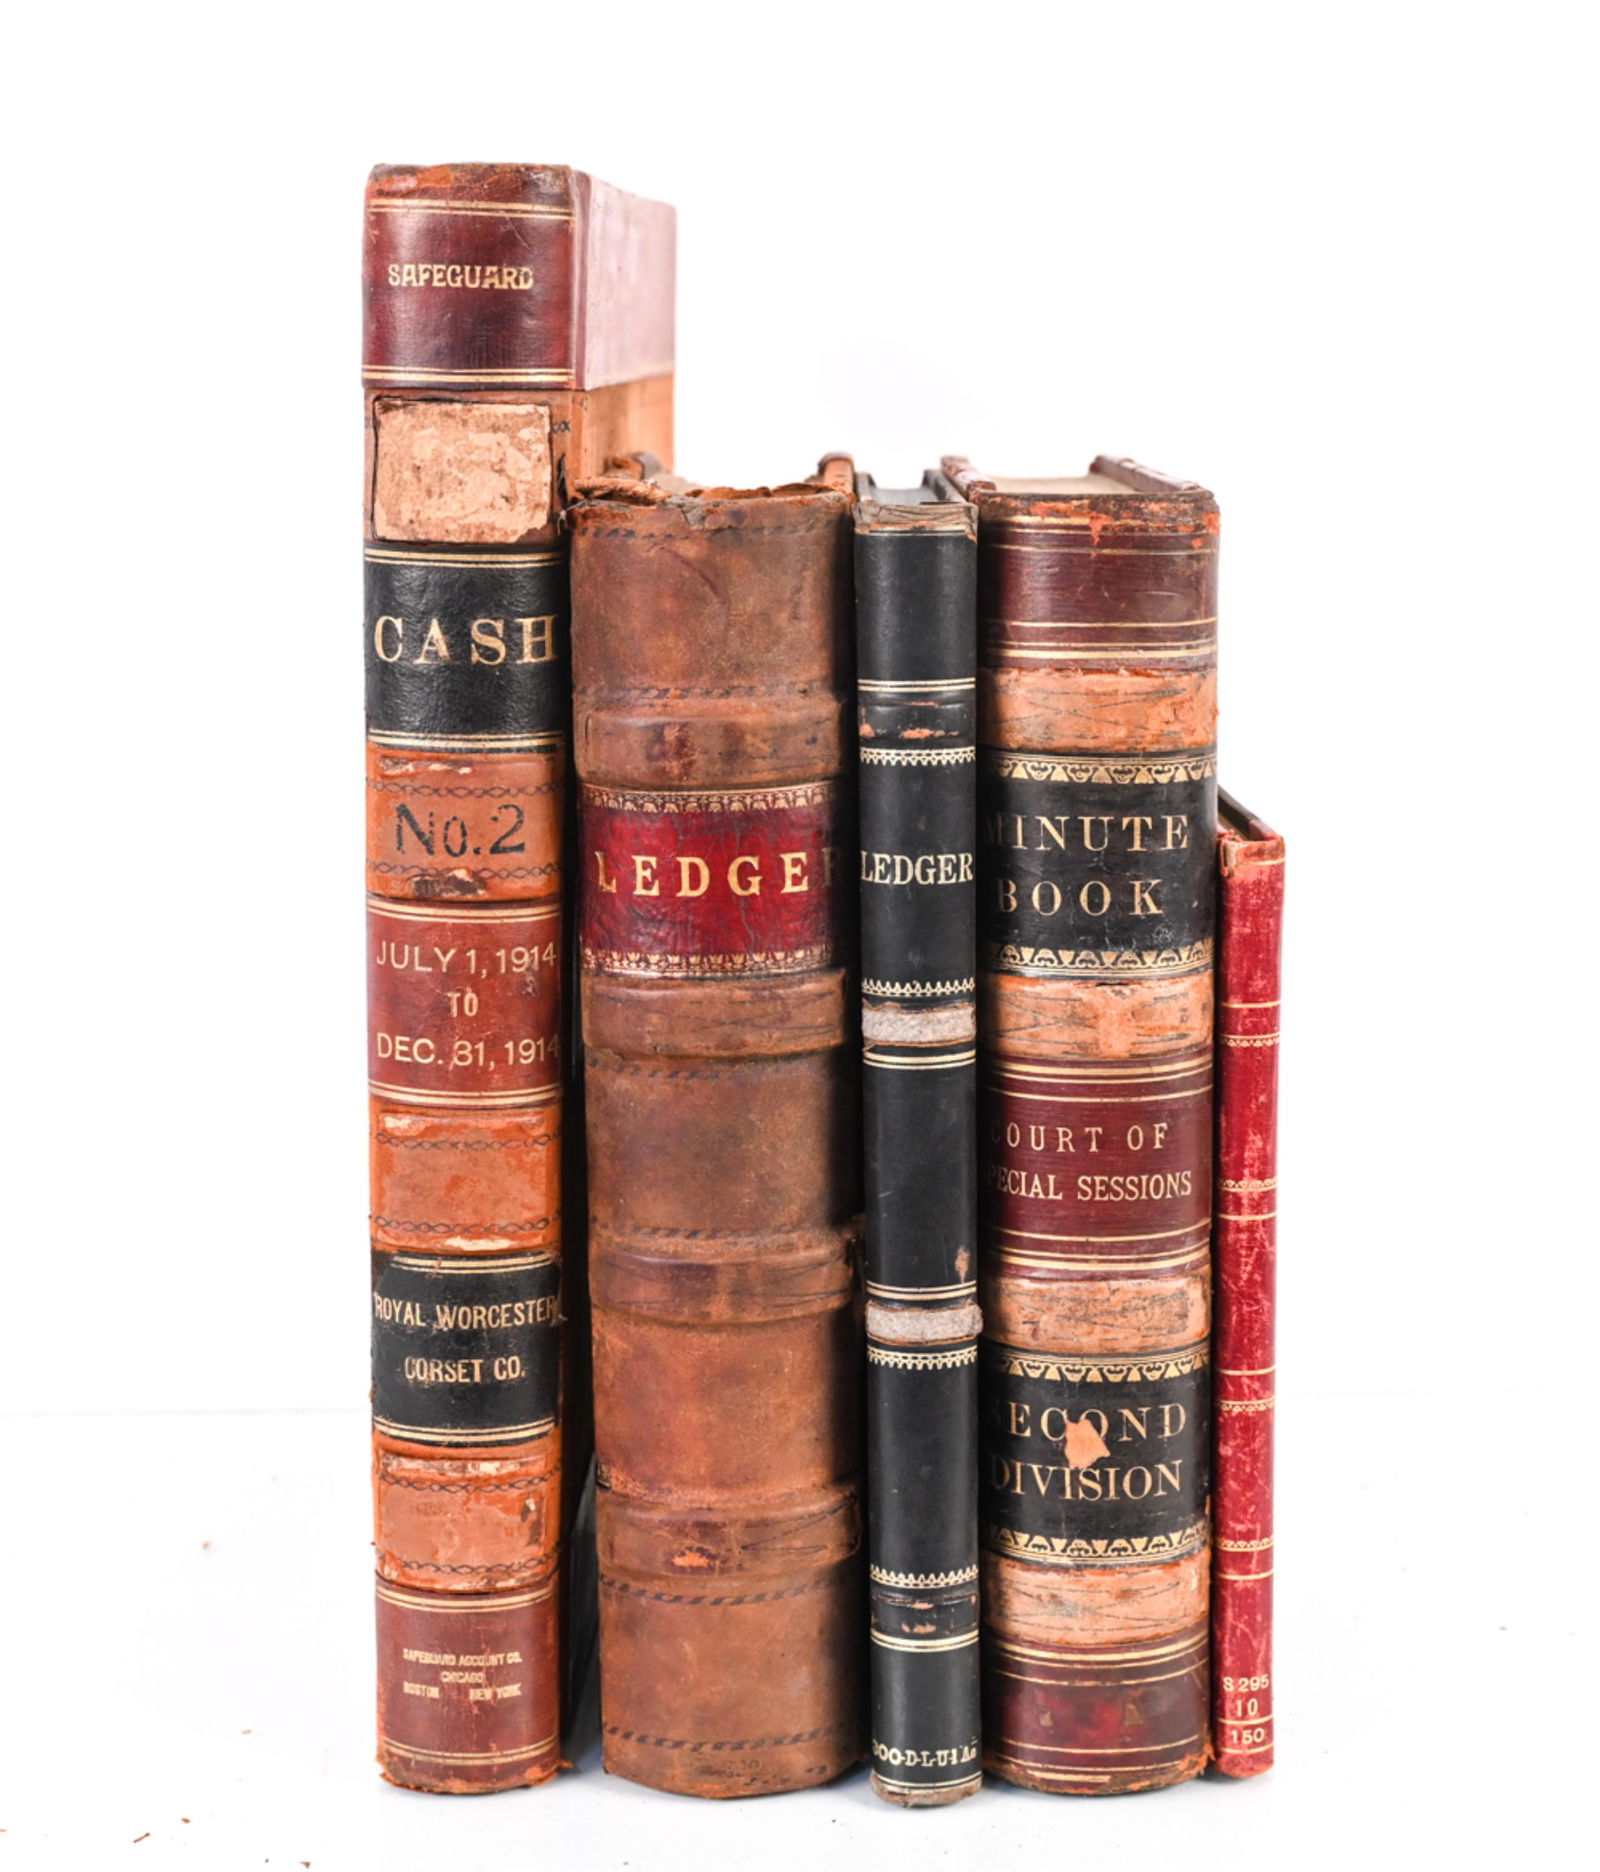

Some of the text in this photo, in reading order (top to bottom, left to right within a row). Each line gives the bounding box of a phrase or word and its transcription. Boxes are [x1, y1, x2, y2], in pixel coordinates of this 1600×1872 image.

[388, 264, 534, 290] SAFEGUARD
[374, 614, 558, 666] CASH
[860, 850, 974, 886] LEDGER
[996, 877, 1164, 917] BOOK
[376, 940, 557, 979] JULY 1, 1914
[447, 990, 480, 1018] TO
[376, 1032, 560, 1072] DEC. 31, 1914
[1127, 1121, 1169, 1151] OF
[985, 1163, 1193, 1201] PECIAL SESSIONS
[374, 1292, 558, 1332] ROYAL WORCESTER
[403, 1354, 527, 1384] CORSET CO.
[1000, 1401, 1188, 1442] ECOND
[991, 1458, 1184, 1501] DIVISION
[403, 1681, 440, 1699] BOSTON
[440, 1671, 484, 1684] CHICAGO
[1238, 1673, 1270, 1692] 295
[1235, 1698, 1258, 1717] 10
[1231, 1727, 1265, 1745] 150
